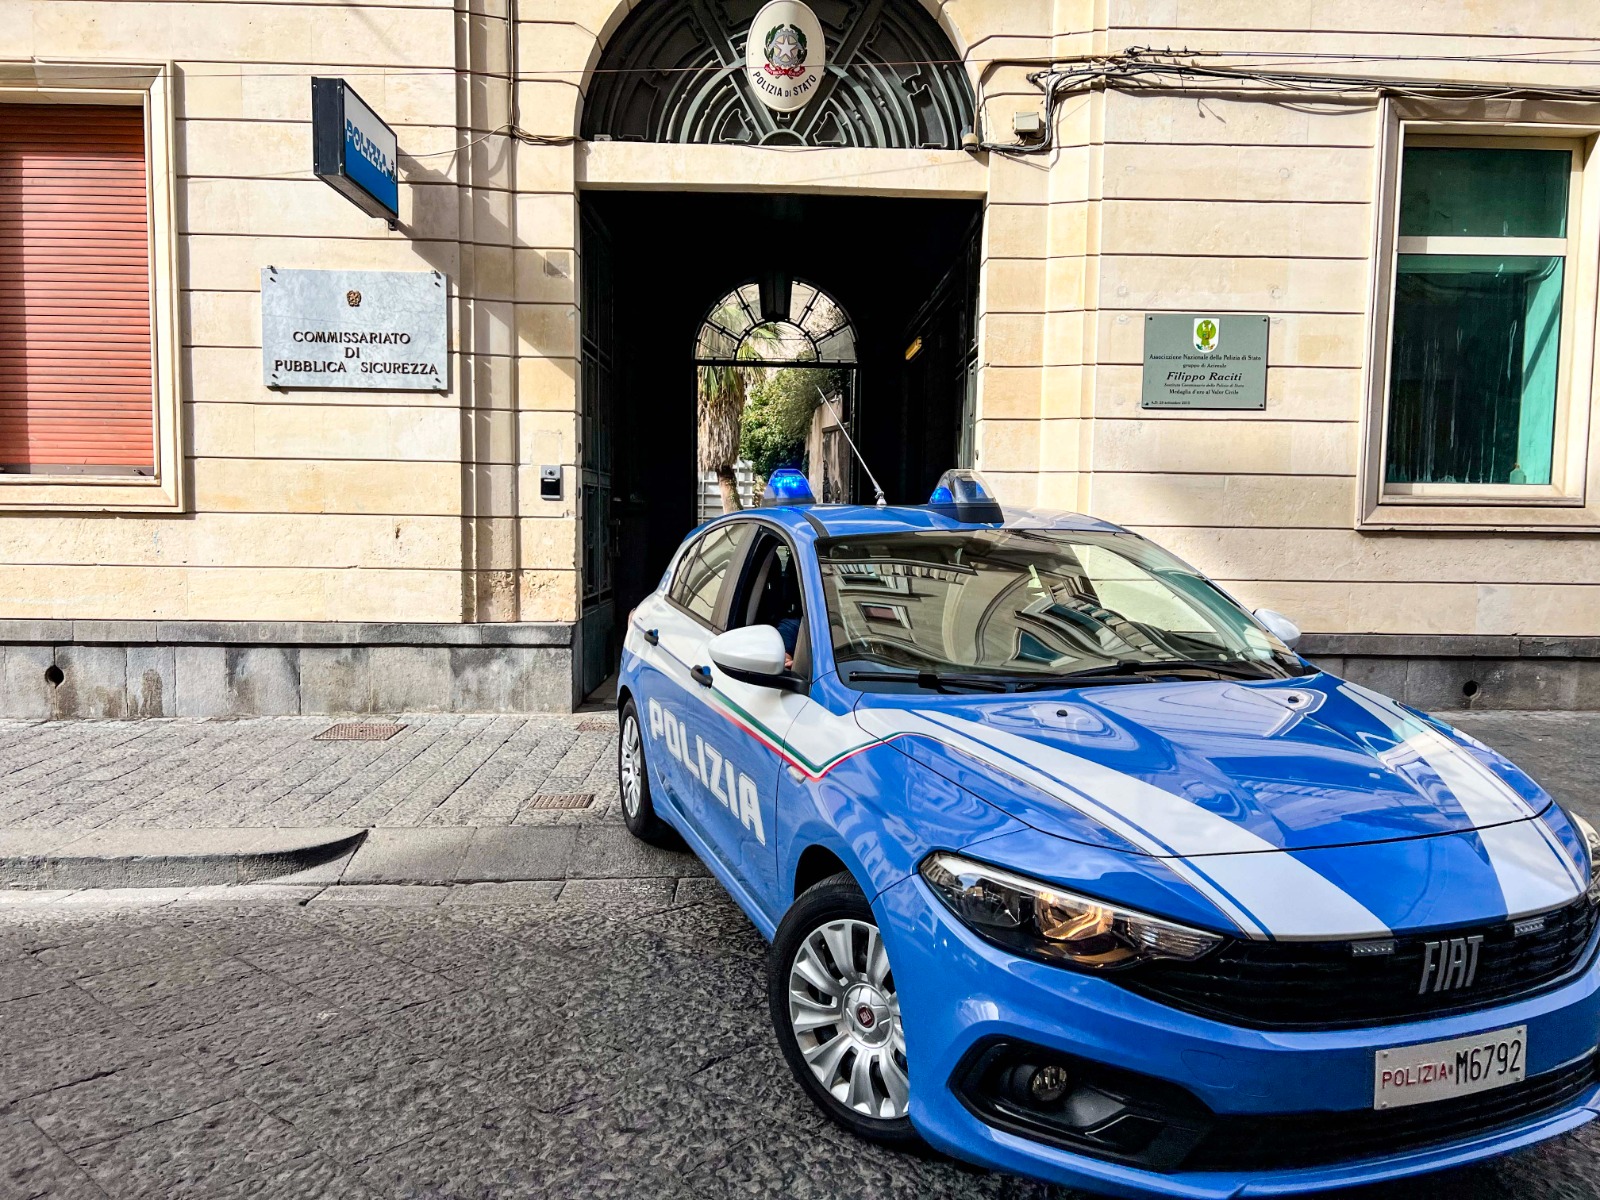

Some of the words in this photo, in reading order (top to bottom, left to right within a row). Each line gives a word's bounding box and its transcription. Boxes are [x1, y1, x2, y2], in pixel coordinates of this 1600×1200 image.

[752, 71, 782, 97] POLIZIA
[793, 74, 817, 96] STATO
[345, 118, 388, 177] POLIZIA
[292, 331, 411, 344] COMMISSARIATO
[344, 347, 360, 359] DI
[274, 360, 347, 373] PUBBLICA
[360, 361, 438, 375] SICUREZZA
[1166, 372, 1206, 382] Filippo
[1208, 372, 1242, 381] Raciti
[649, 697, 766, 847] POLIZIA
[1418, 934, 1484, 995] FIAT
[1381, 1062, 1448, 1089] POLIZIA
[1455, 1039, 1522, 1085] M6792
